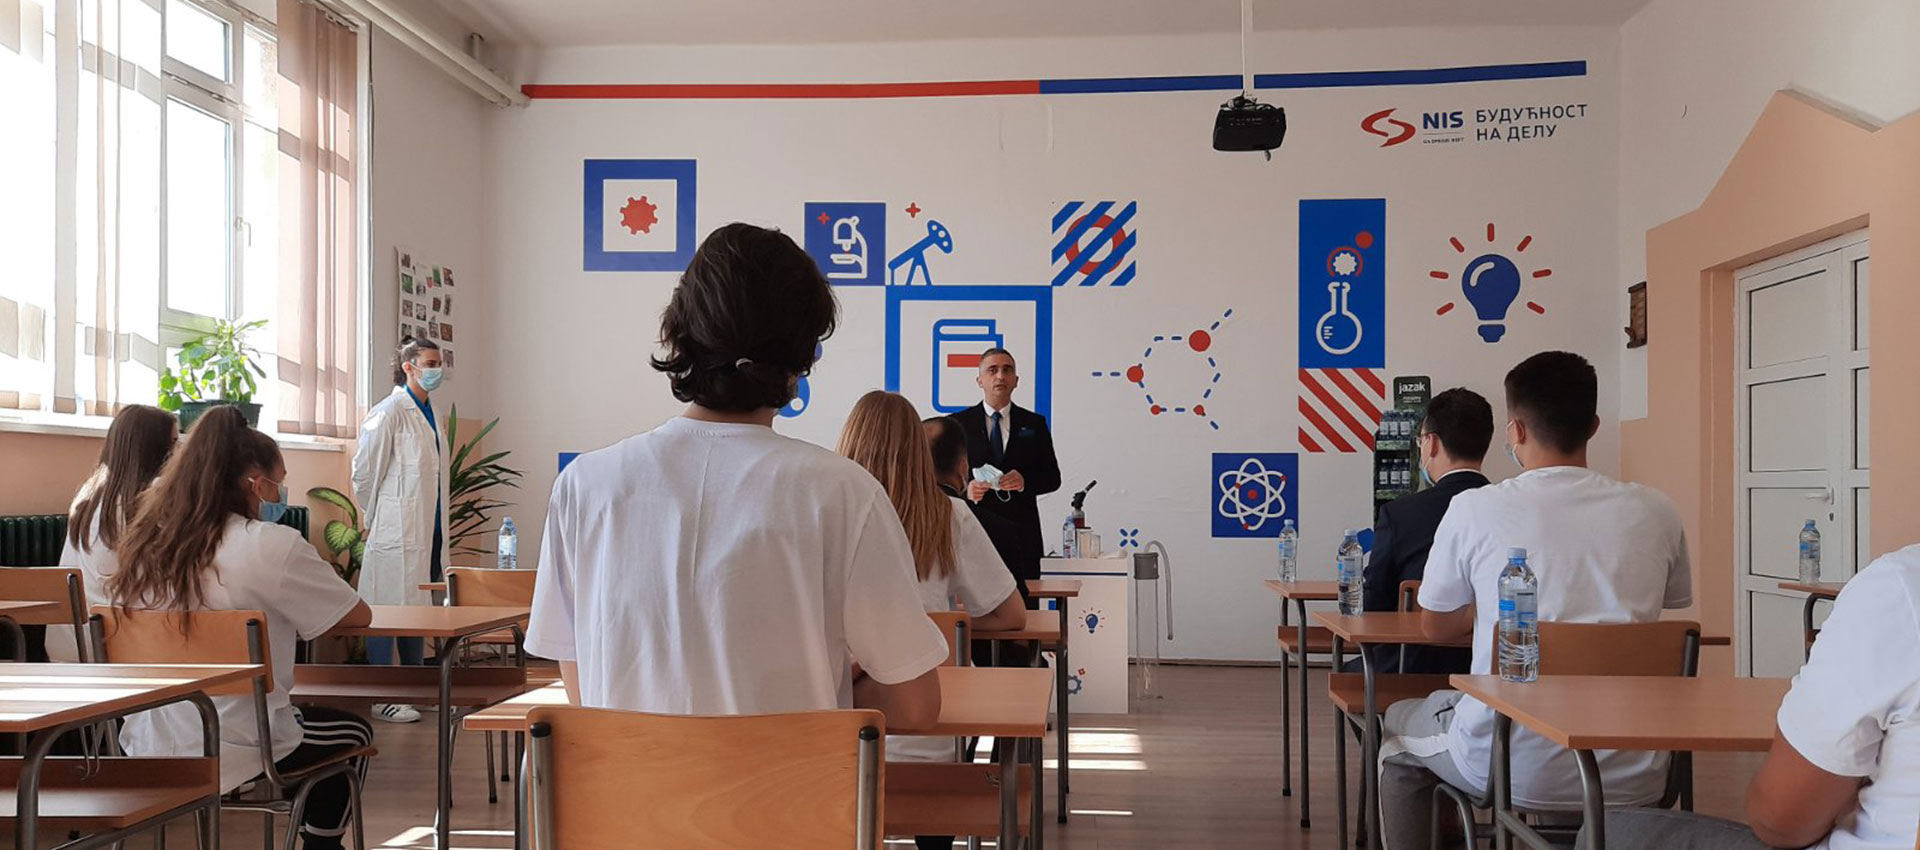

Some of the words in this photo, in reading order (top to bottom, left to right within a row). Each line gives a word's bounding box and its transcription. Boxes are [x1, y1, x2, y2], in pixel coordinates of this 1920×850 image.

[1423, 111, 1464, 129] NIS
[1476, 104, 1587, 124] БУДУЋНОСТ
[1476, 128, 1501, 141] НА
[1507, 125, 1557, 142] ДЕЛУ
[1399, 382, 1426, 394] jazak
